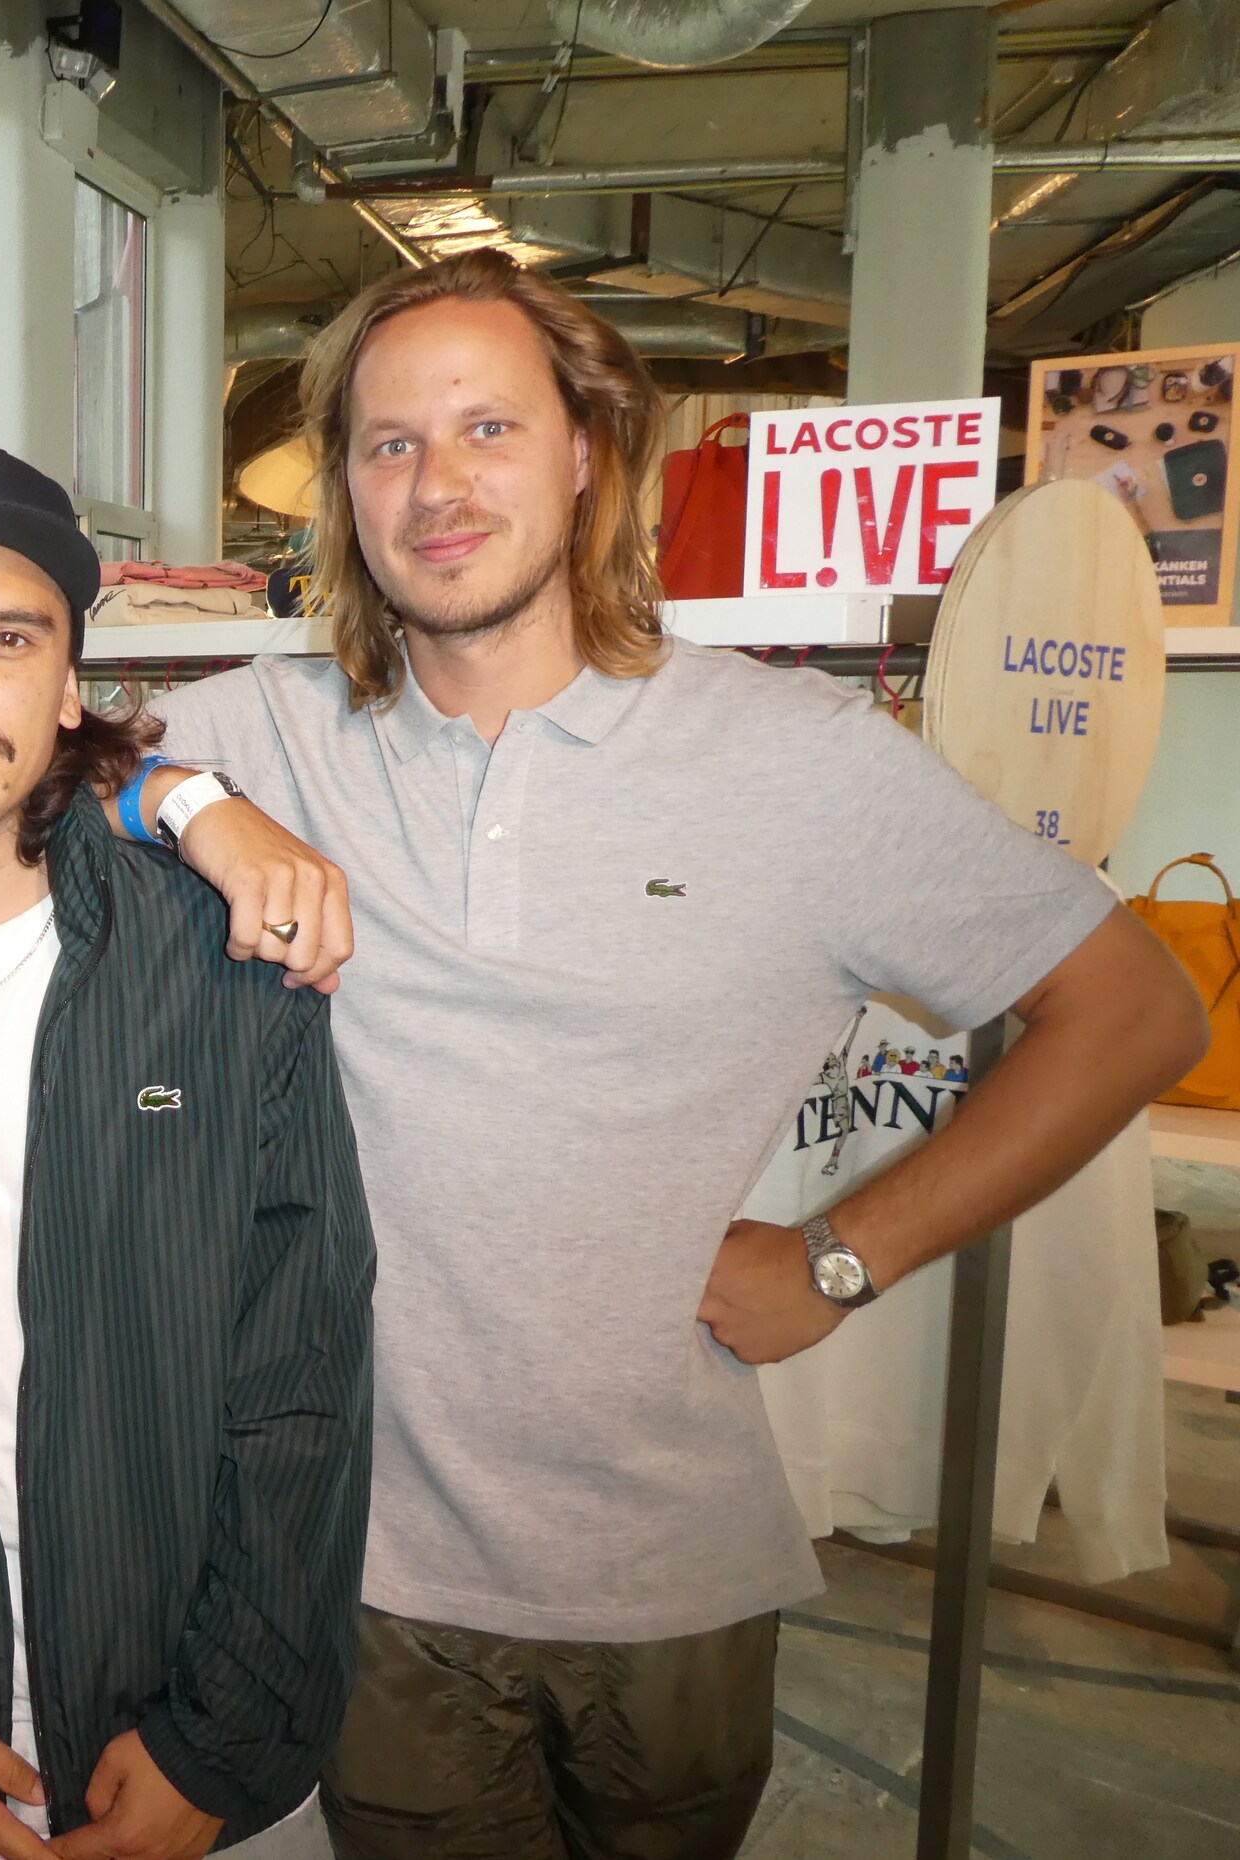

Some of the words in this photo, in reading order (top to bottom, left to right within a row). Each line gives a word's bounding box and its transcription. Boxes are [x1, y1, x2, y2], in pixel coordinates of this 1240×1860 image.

[766, 412, 982, 455] LACOSTE
[1004, 635, 1126, 682] LACOSTE
[1030, 697, 1090, 736] LIVE
[793, 1080, 968, 1151] TENN
